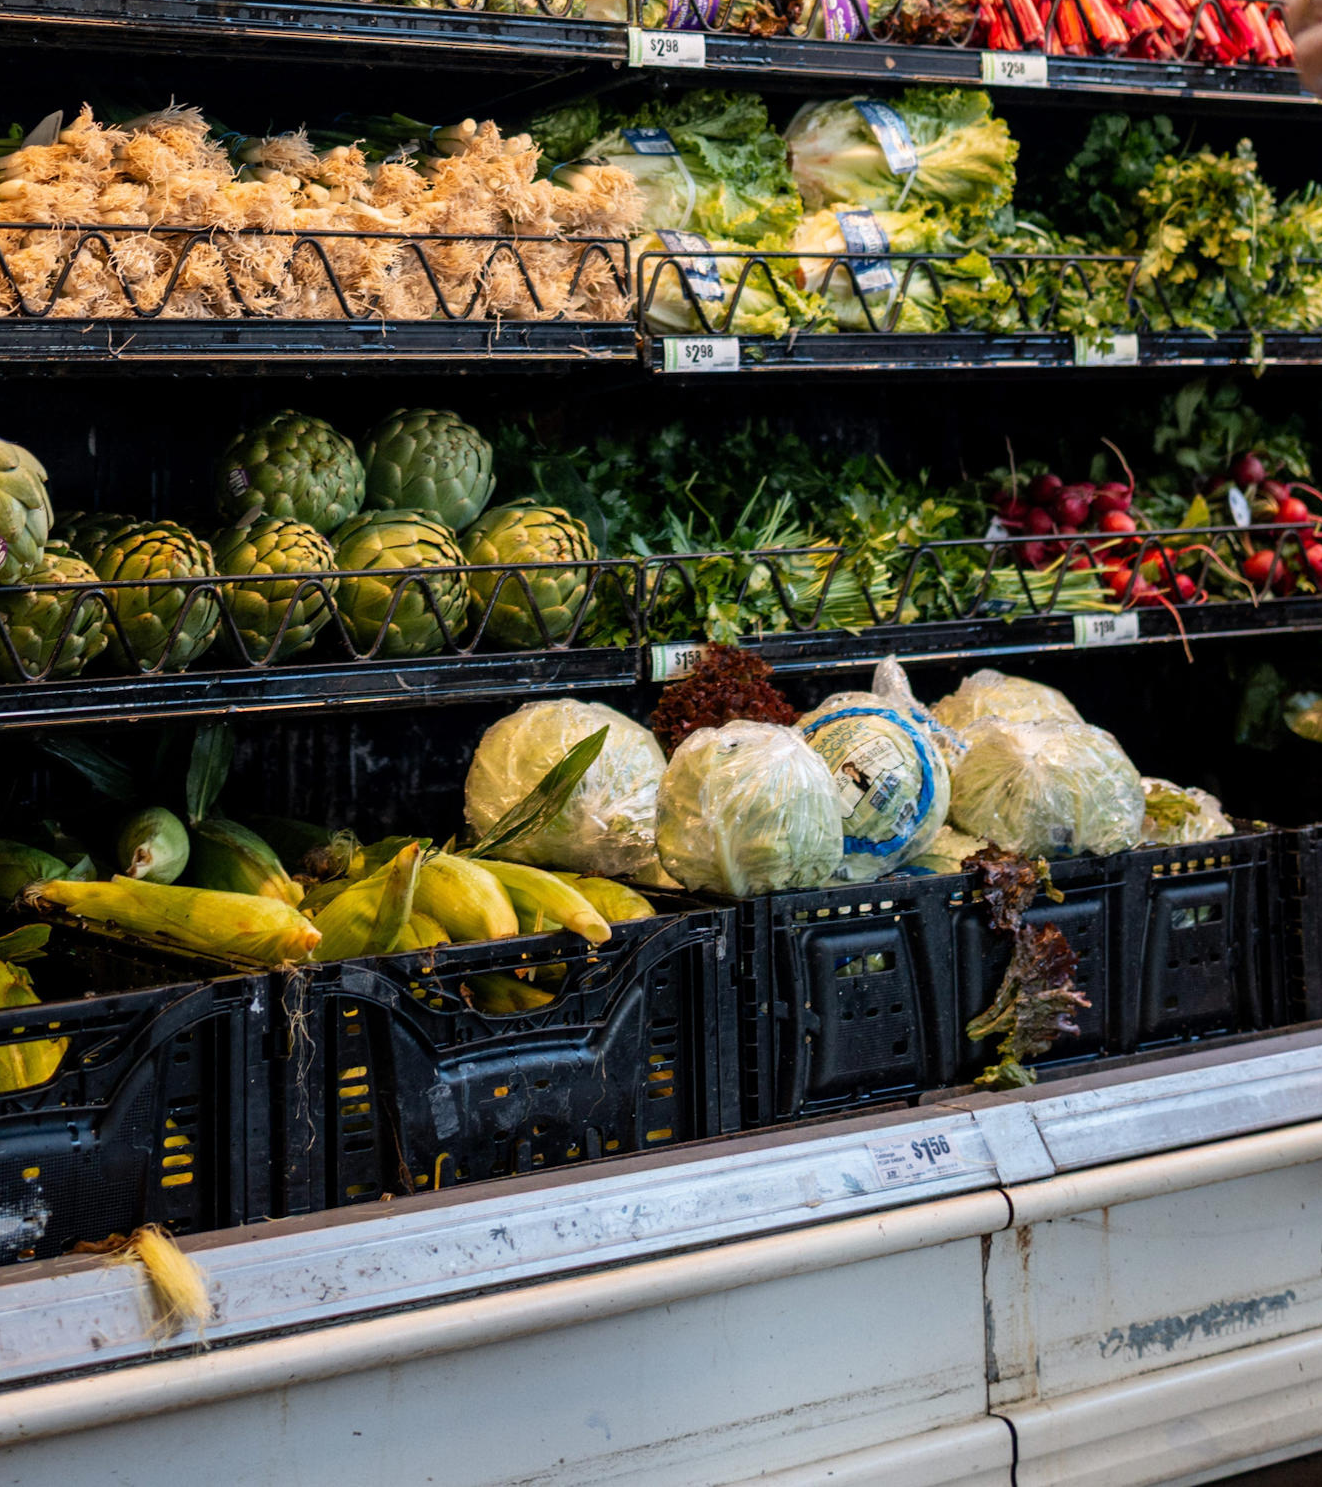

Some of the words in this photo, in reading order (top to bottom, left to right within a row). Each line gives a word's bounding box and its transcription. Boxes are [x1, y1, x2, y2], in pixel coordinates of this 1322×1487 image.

[650, 38, 679, 57] $298
[685, 344, 714, 364] $298
[675, 650, 702, 671] $158
[910, 1134, 951, 1165] $156
